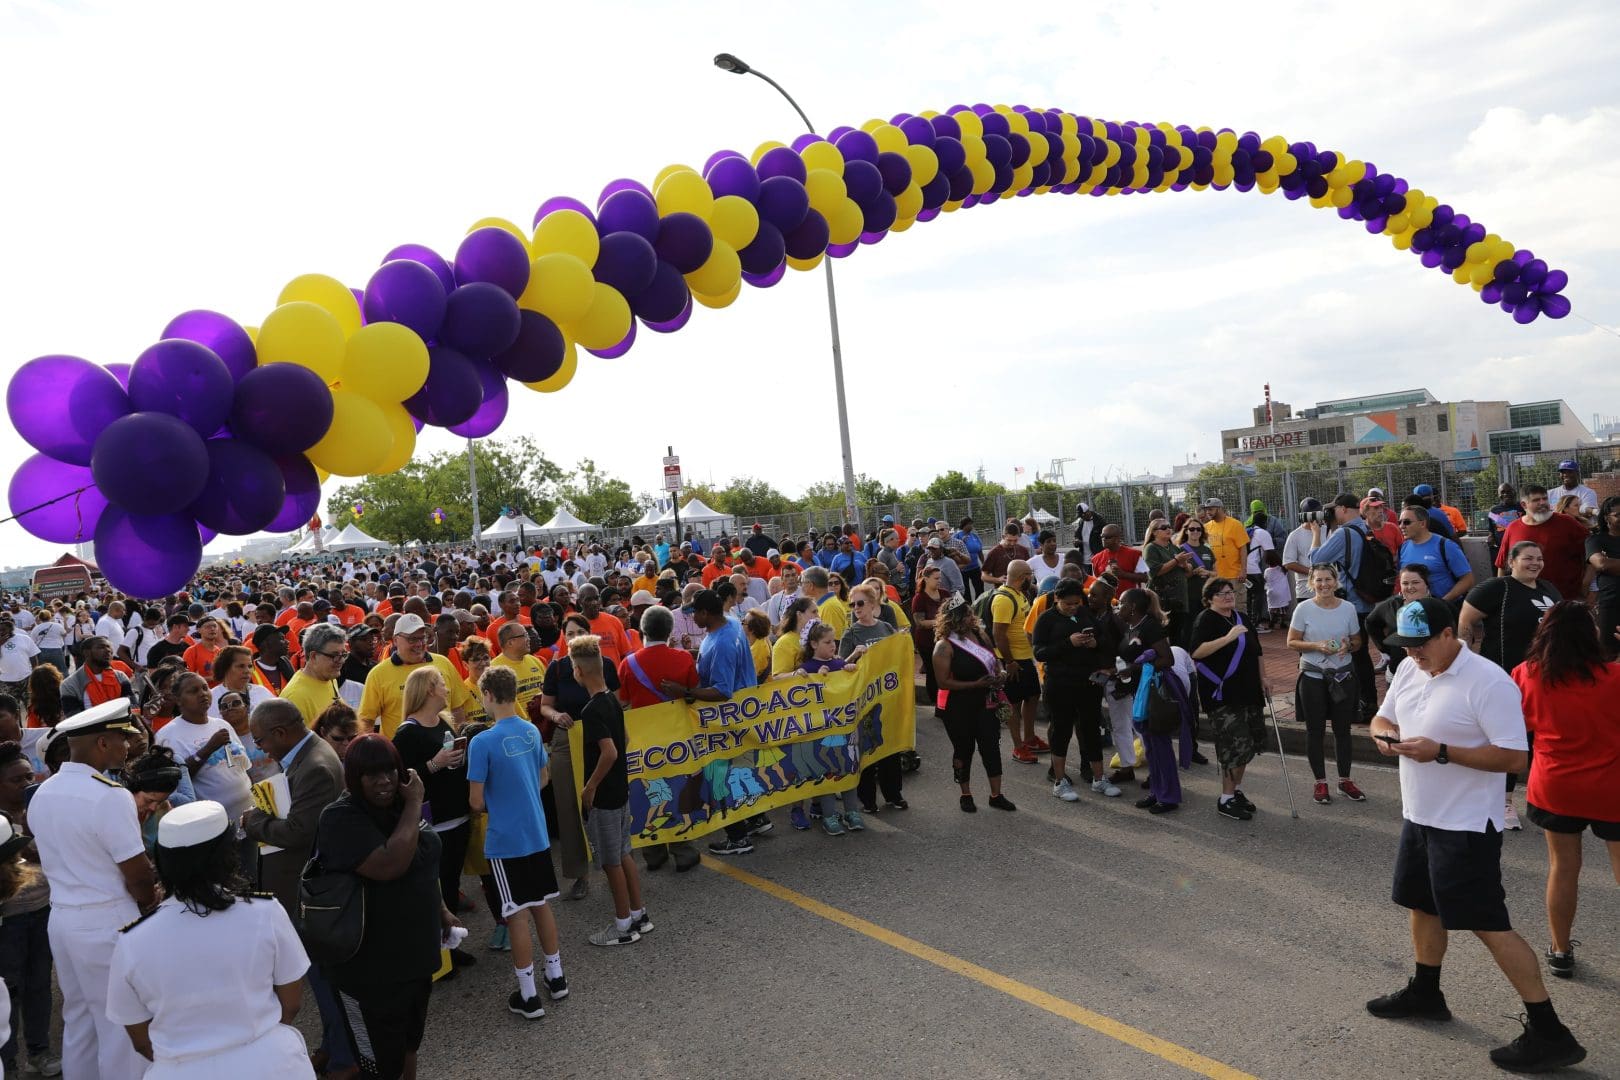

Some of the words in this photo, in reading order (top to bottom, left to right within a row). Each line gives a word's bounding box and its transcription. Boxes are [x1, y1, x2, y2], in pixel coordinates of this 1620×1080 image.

[1242, 432, 1303, 449] SEAPORT
[698, 682, 826, 728] PRO-ACT
[625, 727, 750, 775] ECOVERY
